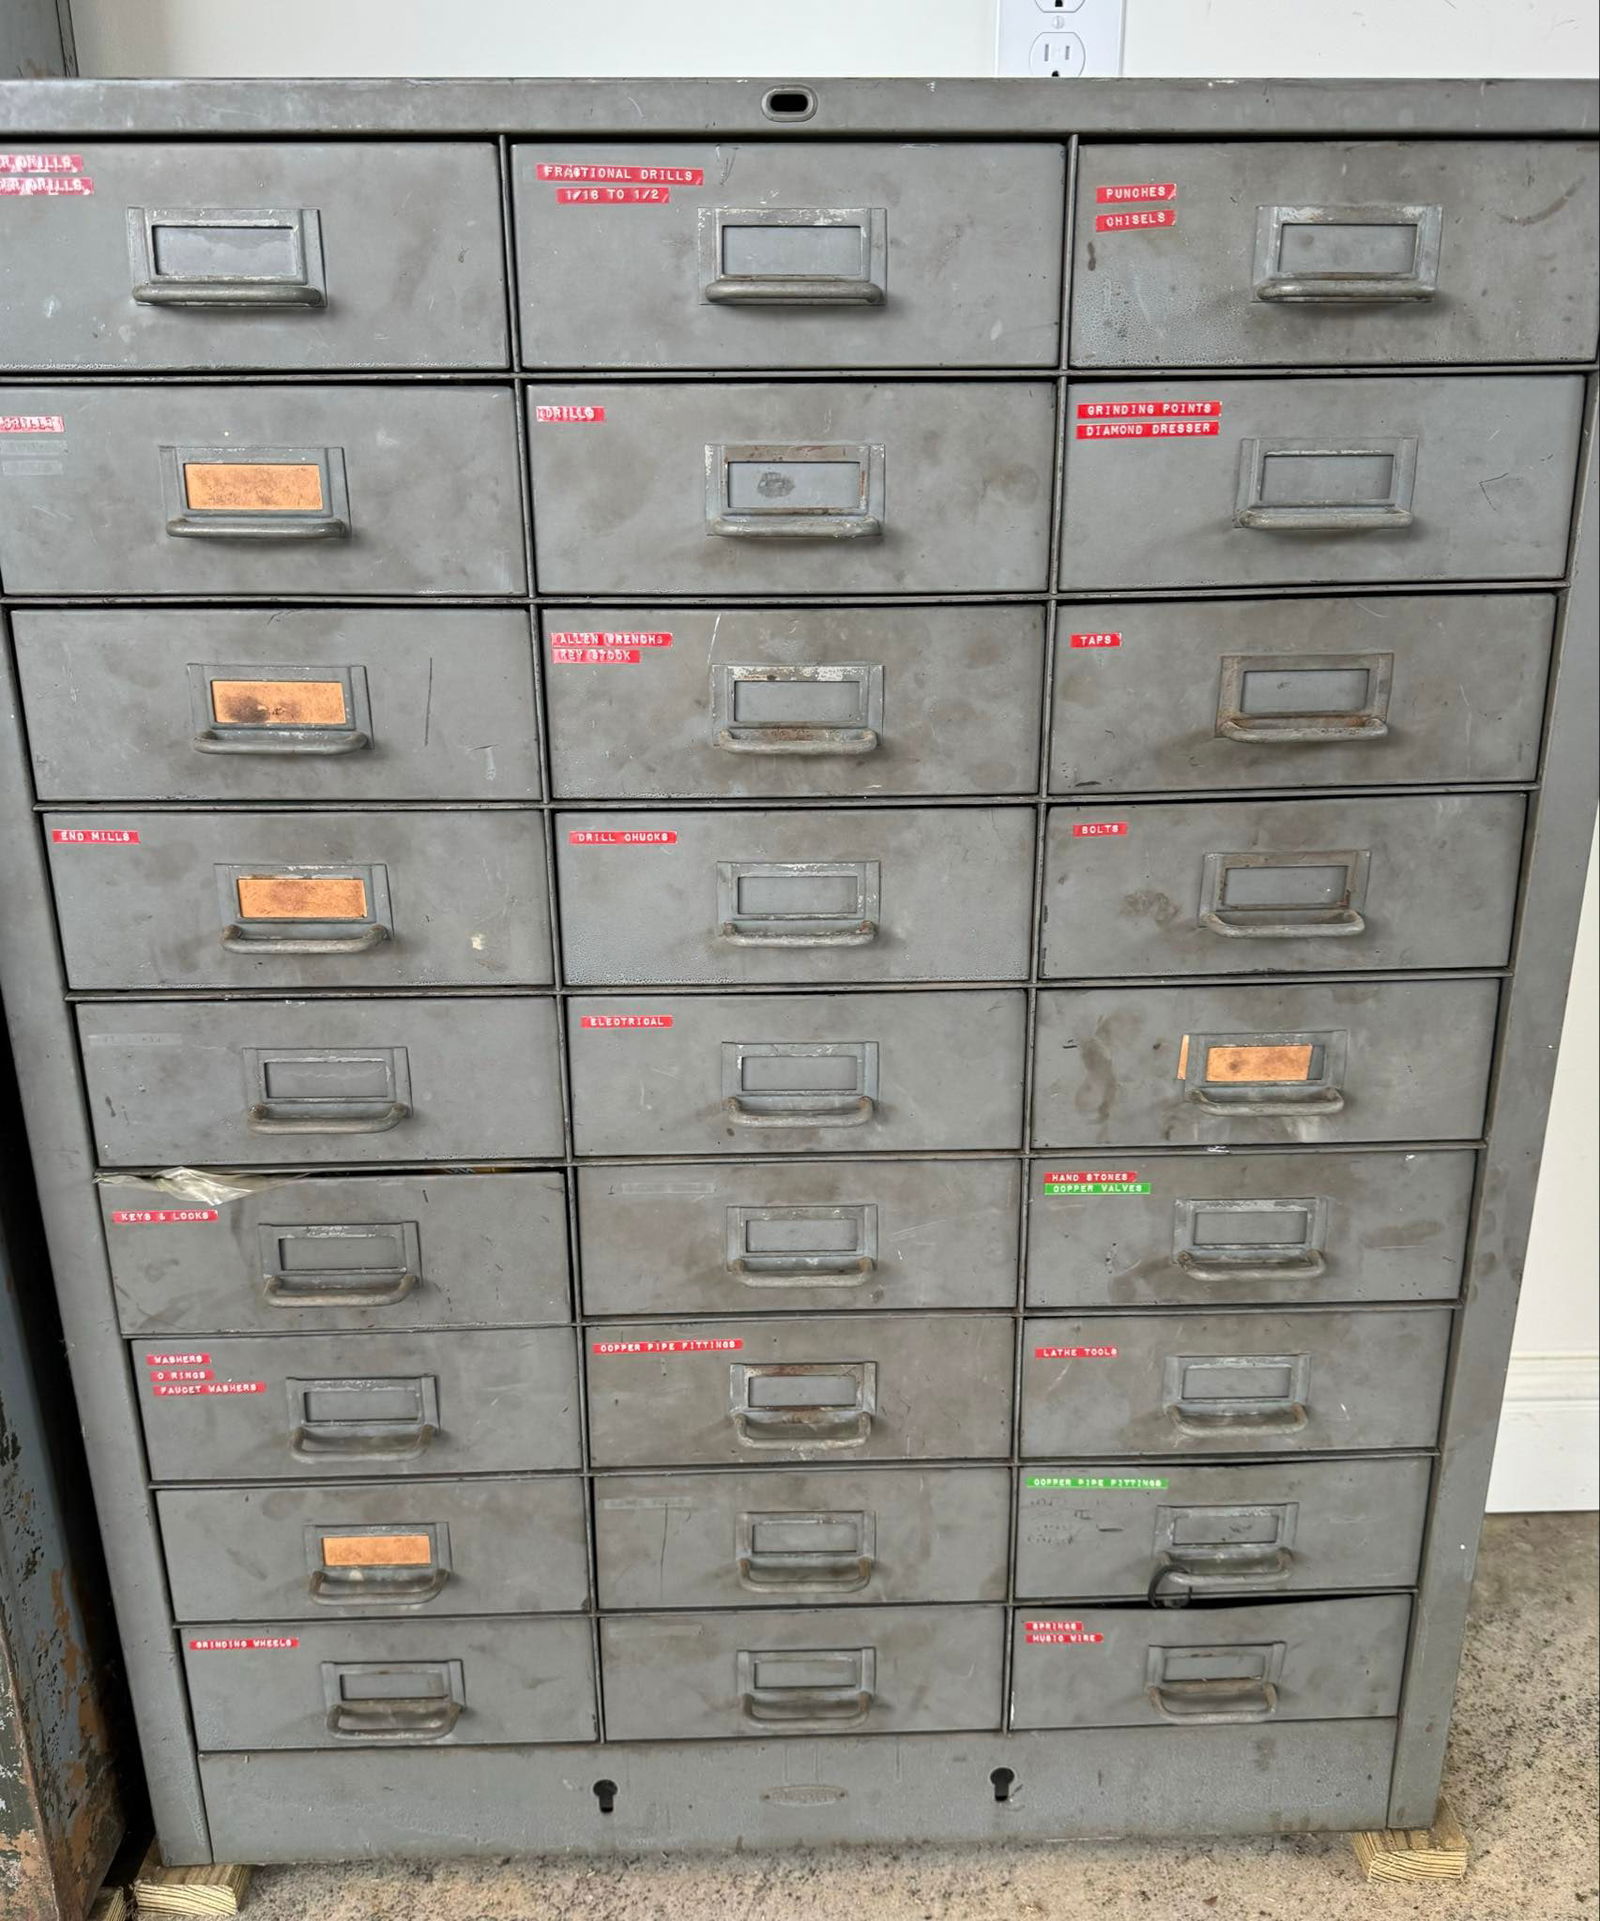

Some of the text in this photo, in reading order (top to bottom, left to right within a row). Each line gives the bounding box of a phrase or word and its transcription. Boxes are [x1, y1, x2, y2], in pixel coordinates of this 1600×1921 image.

[543, 165, 694, 182] FRACTIONAL DRILLS
[606, 188, 625, 200] TO
[633, 188, 660, 200] 1/2
[1105, 186, 1166, 199] PUNCHES
[1105, 211, 1166, 228] CHISELS
[1086, 402, 1212, 416] GRINDING POINTS
[1085, 422, 1211, 437] DIAMOND DRESSER
[559, 632, 599, 645] ALLEN
[1079, 634, 1112, 646] TAPS
[1081, 823, 1119, 835] BOLTS
[60, 831, 131, 842] END MILLS
[577, 832, 669, 842] DRILL CHUCKS
[589, 1017, 665, 1027] ELECTRICAL
[1051, 1172, 1129, 1183] HAND STONES
[1052, 1184, 1143, 1193] COPPER VALVES
[120, 1212, 152, 1222] KEYS
[158, 1212, 167, 1221] &
[599, 1340, 736, 1353] COPPER PIPE FITTINGS
[1043, 1347, 1118, 1357] LATHE TOOLS
[153, 1354, 203, 1364] WASHERS
[156, 1371, 206, 1380] O RINGS
[159, 1383, 257, 1395] FAUCET WASHERS
[1033, 1478, 1162, 1487] COPPER PIPE FITTINGS
[195, 1638, 293, 1650] GRINDING WHEELS
[1069, 1634, 1096, 1643] WIRE
